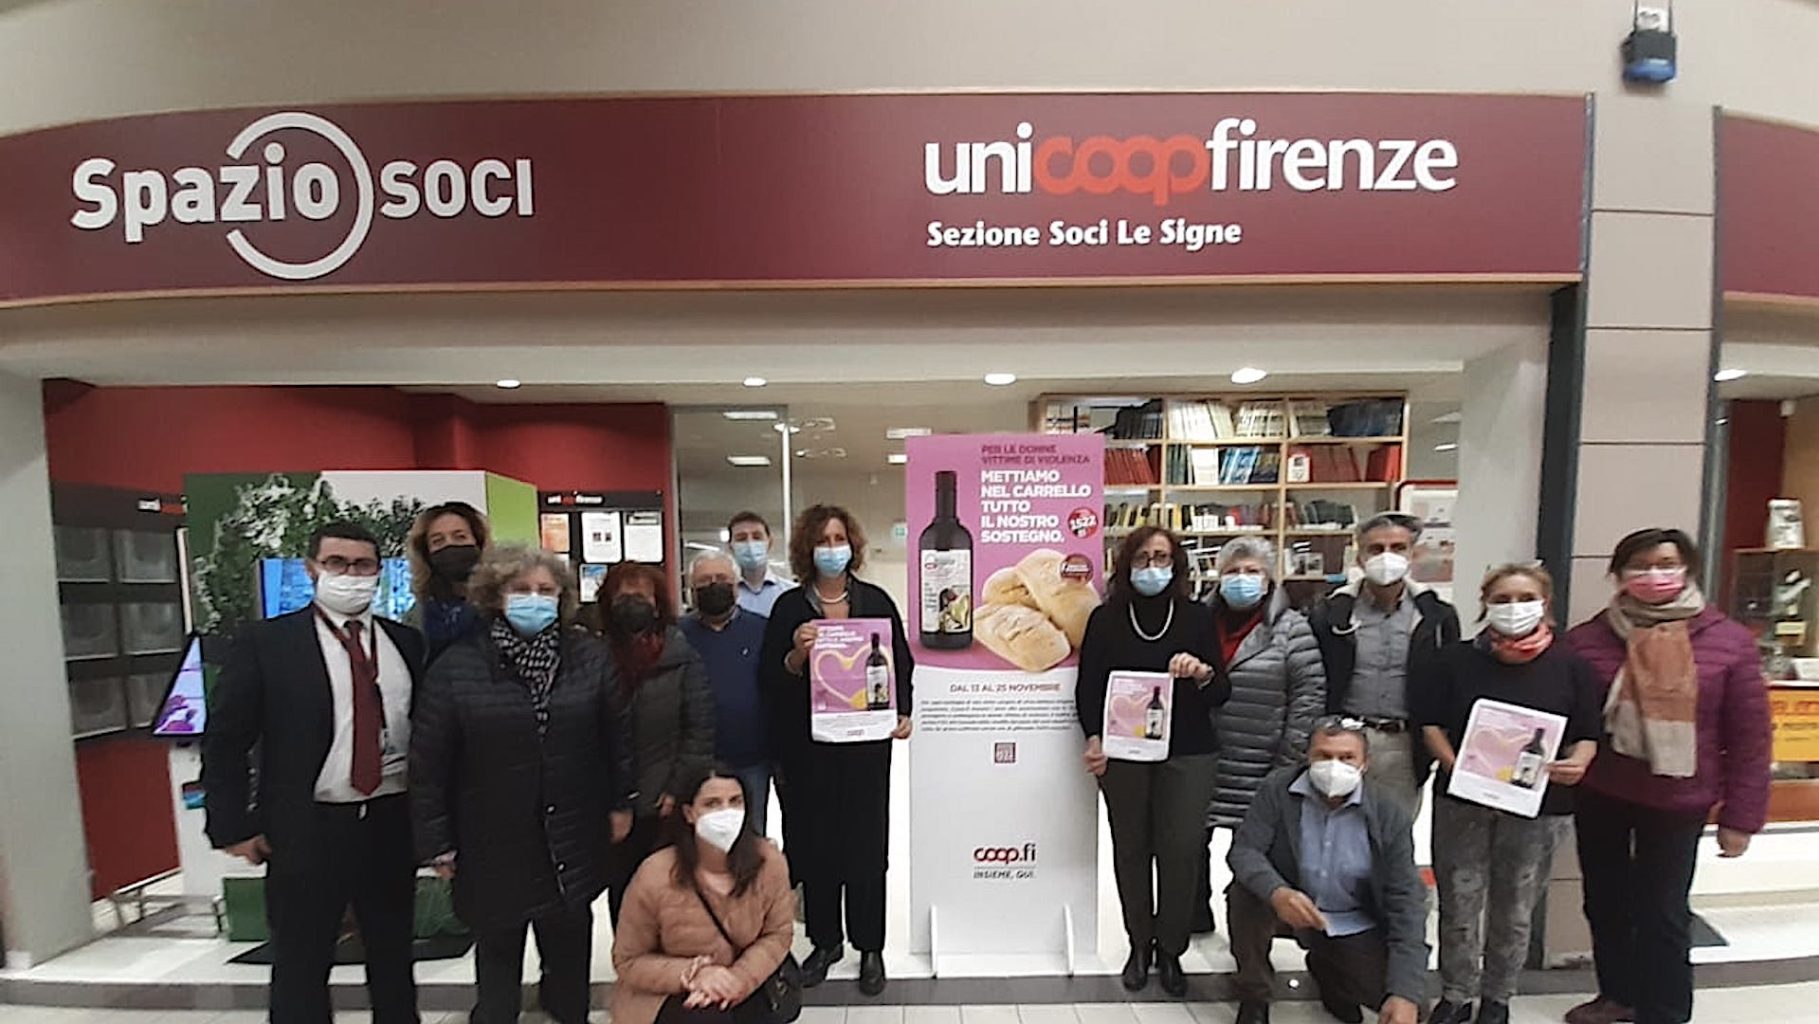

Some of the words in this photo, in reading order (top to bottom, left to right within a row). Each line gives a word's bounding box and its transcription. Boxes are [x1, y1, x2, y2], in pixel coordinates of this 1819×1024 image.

[925, 118, 1458, 206] unicoopfirenze
[71, 142, 339, 242] Spazio
[927, 220, 1040, 247] Sezione
[1049, 219, 1108, 246] Soci
[1118, 220, 1151, 246] Le
[1160, 218, 1242, 252] Signe
[982, 445, 1001, 454] PER
[1004, 445, 1016, 454] LE
[1019, 444, 1056, 454] DONNE
[982, 455, 1021, 464] VITTIME
[1024, 455, 1035, 464] DI
[1038, 455, 1090, 464] VIOLENZA
[981, 470, 1060, 483] METTIAMO
[981, 485, 1011, 498] NEL
[1013, 484, 1092, 498] CARRELLO
[981, 500, 1031, 513] TUTTO
[981, 515, 995, 528] IL
[997, 515, 1060, 528] NOSTRO
[981, 529, 1065, 543] SOSTEGNO.
[950, 684, 968, 692] DAL
[982, 684, 995, 692] AL
[996, 684, 1007, 692] 25
[1009, 683, 1061, 692] NOVEMBRE
[974, 842, 1036, 865] coop.fi
